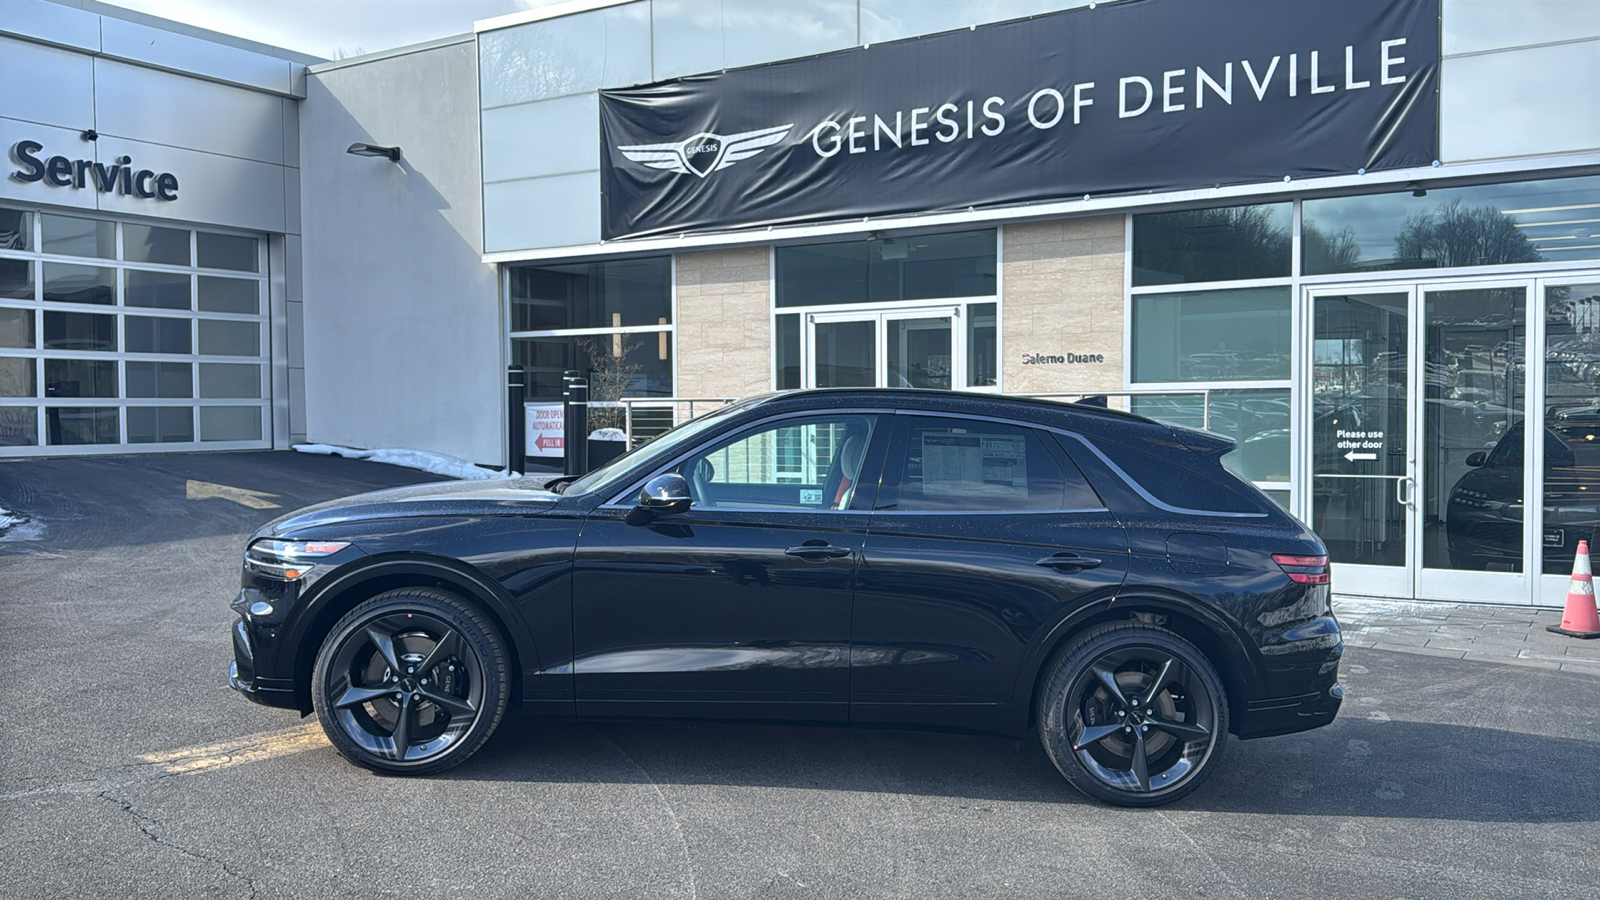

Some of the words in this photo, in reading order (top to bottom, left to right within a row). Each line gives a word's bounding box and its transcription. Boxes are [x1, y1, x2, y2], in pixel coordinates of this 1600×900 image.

[812, 96, 1005, 158] GENESIS
[1027, 82, 1095, 129] OF
[1118, 38, 1407, 118] DENVILLE
[687, 144, 717, 155] GENESIS
[10, 140, 179, 201] Service
[1022, 353, 1064, 364] Salerno
[1067, 352, 1104, 363] Duane
[536, 410, 550, 419] DOOR
[1336, 430, 1366, 438] Please
[543, 439, 554, 447] PULL
[555, 439, 560, 447] IN
[1337, 440, 1361, 448] other
[1362, 440, 1383, 448] door
